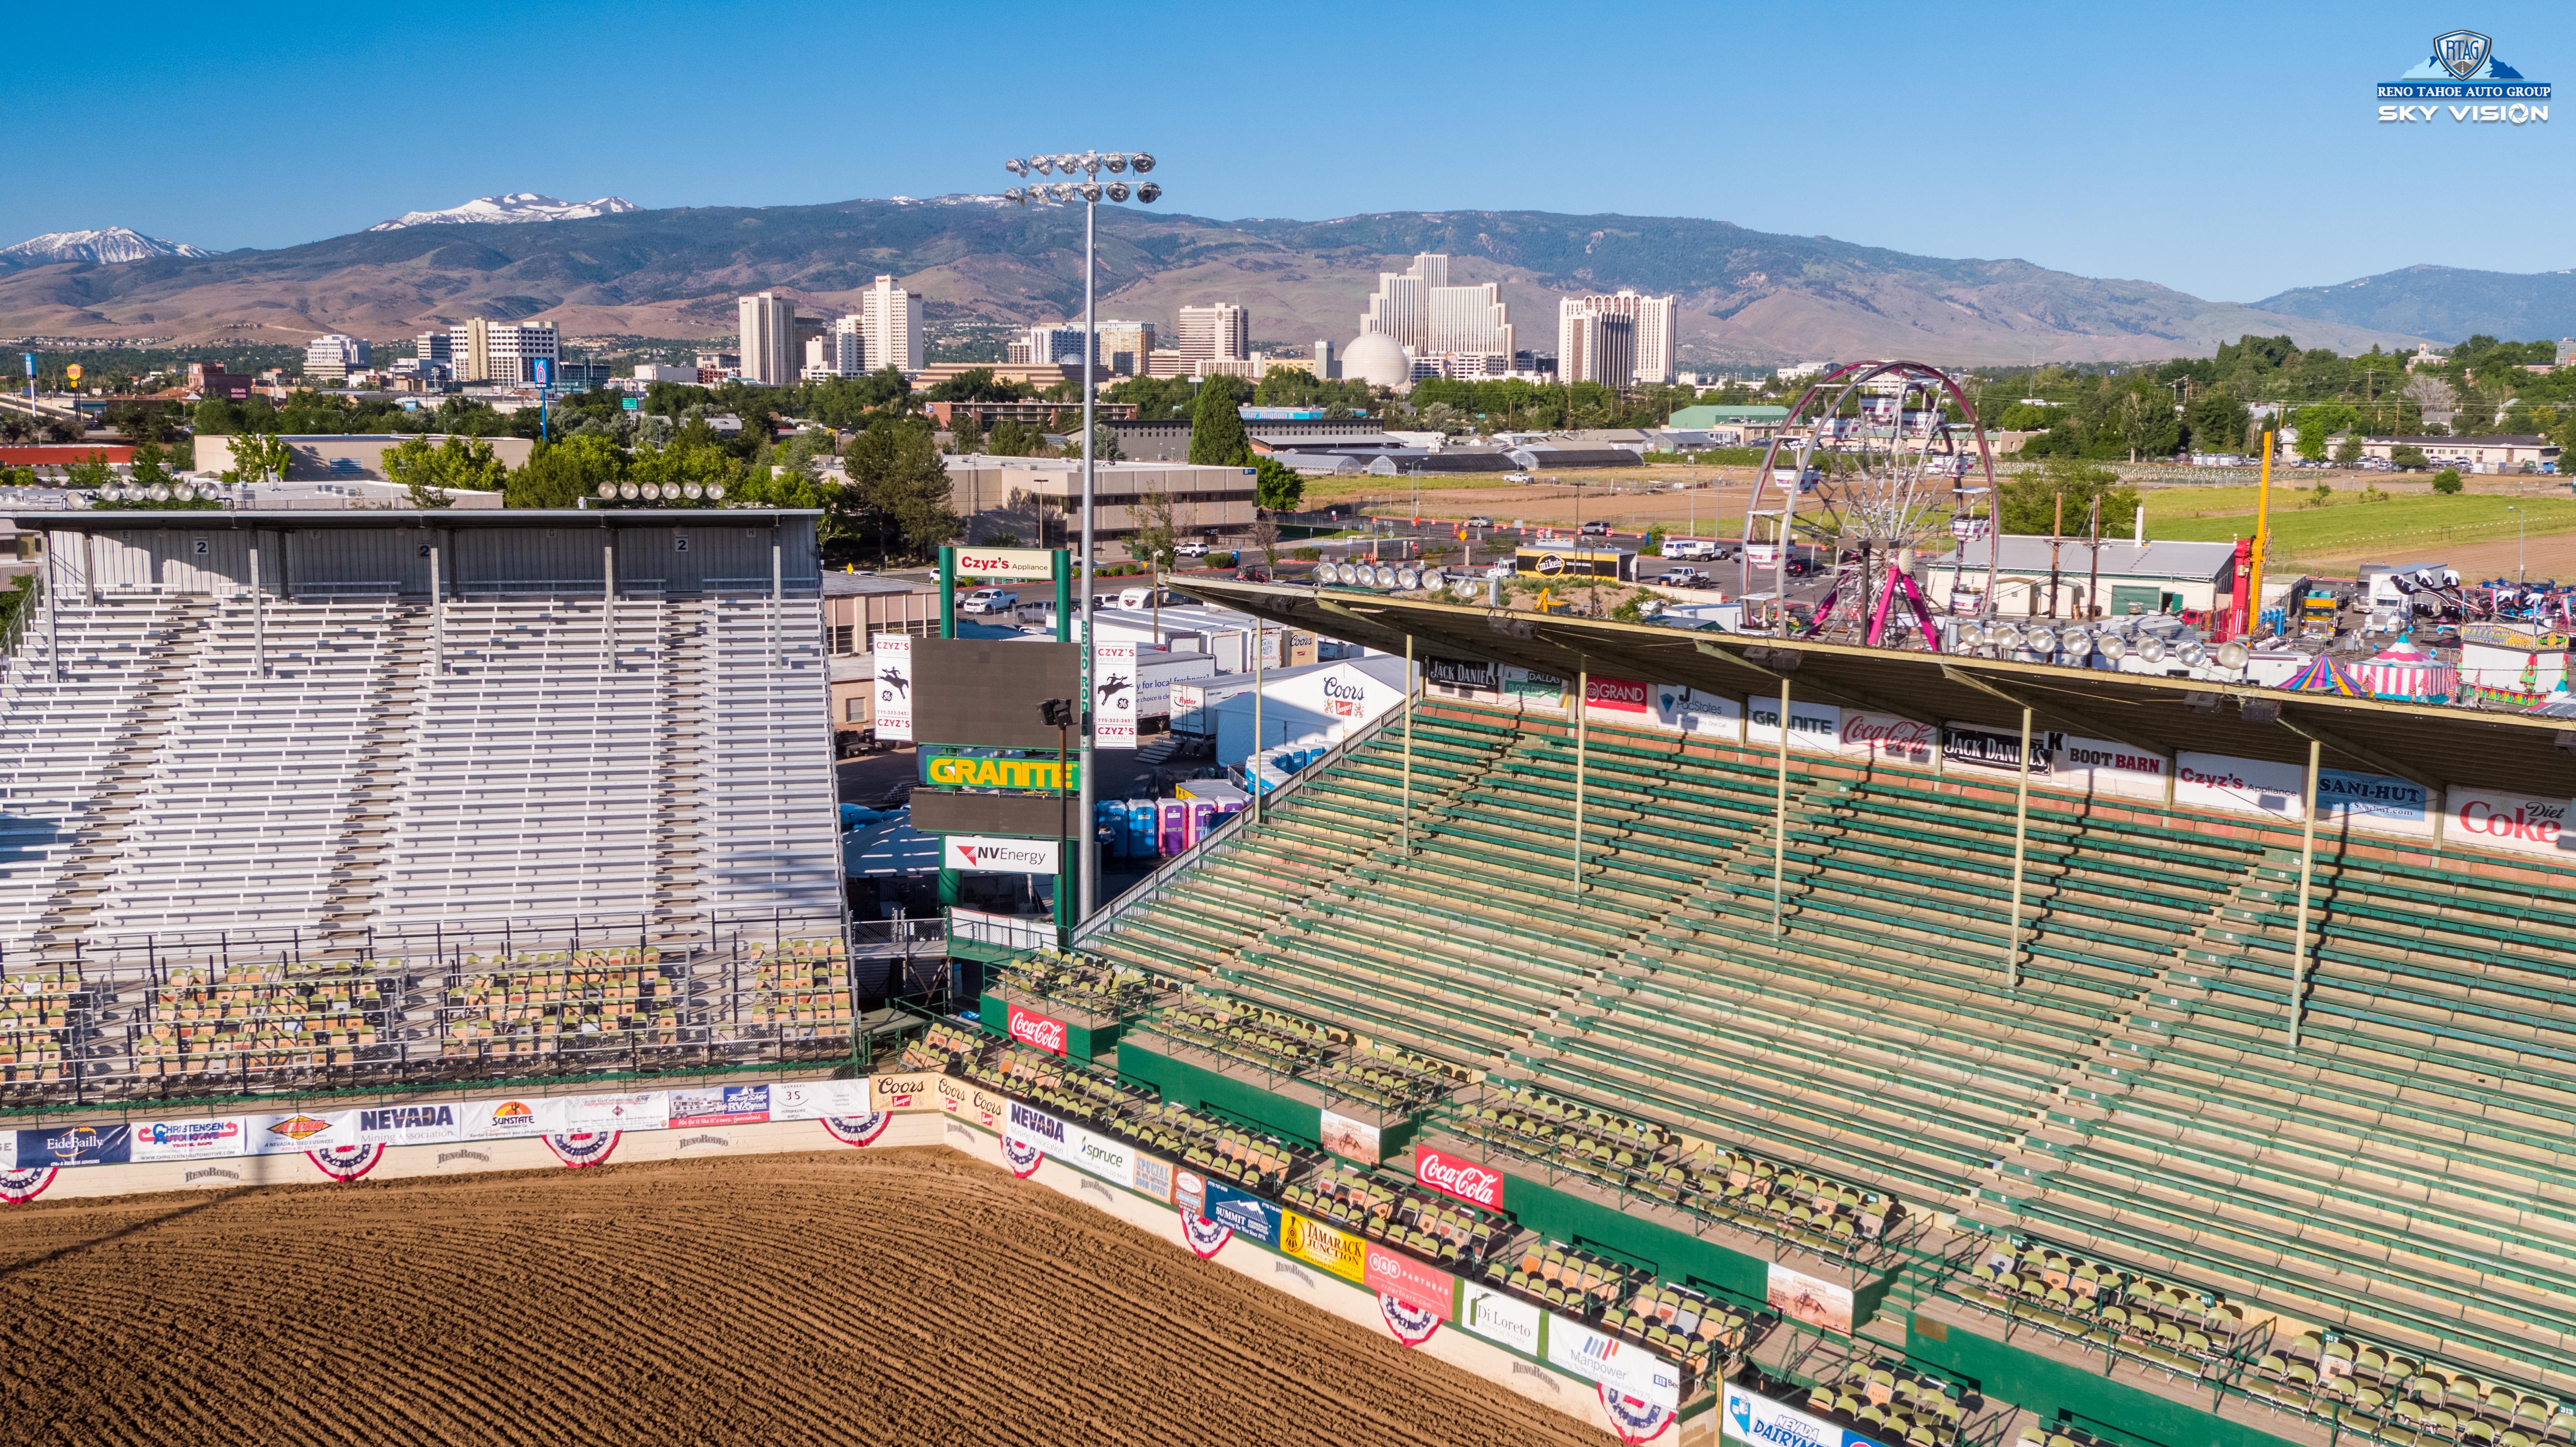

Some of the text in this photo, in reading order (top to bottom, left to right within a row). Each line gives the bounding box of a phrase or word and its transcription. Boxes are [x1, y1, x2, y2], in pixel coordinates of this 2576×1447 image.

[537, 361, 545, 383] 6
[197, 542, 207, 553] 2
[420, 545, 430, 557] 2
[678, 540, 687, 550] 2
[962, 556, 1009, 571] Czyz's
[1540, 559, 1563, 571] mike's
[877, 642, 909, 650] CZYZ'S
[1290, 635, 1312, 647] Coors
[1155, 678, 1172, 688] local
[1430, 661, 1455, 681] JACK
[1458, 664, 1496, 685] DANIELS
[1529, 673, 1560, 683] DALLAS
[1324, 677, 1364, 701] Coors
[1509, 684, 1529, 693] FLOOR
[1600, 684, 1644, 702] GRAND
[1179, 697, 1197, 705] Ryder
[877, 719, 910, 727] CZYZ'S
[1098, 727, 1134, 735] CZYZ'S
[1843, 716, 1932, 755] Coca-Cola
[2048, 732, 2064, 751] K
[1944, 733, 1982, 758] JACK
[1985, 738, 2047, 767] DANIL'S.
[2070, 747, 2160, 773] BOOT BARN
[930, 758, 1072, 788] GRANITE
[2180, 767, 2297, 796] Czyz's Appliance
[2318, 778, 2420, 803] SANI-HUT
[2459, 801, 2561, 844] Coke
[2525, 802, 2565, 819] Diet
[1010, 1012, 1063, 1049] Coca-Cola
[878, 1077, 925, 1094] Coors
[938, 1077, 966, 1101] Coors
[973, 1090, 1001, 1115] Coors
[361, 1106, 453, 1131] NEVADA
[492, 1115, 535, 1126] SUNSTATE
[1010, 1103, 1065, 1143] NEVADA
[361, 1129, 453, 1143] Mining ssociation
[1010, 1126, 1063, 1154] Mining Association
[1086, 1144, 1122, 1167] spruce
[1137, 1157, 1168, 1182] SPECIAL
[1420, 1154, 1498, 1205] Coca-Cola
[1216, 1207, 1246, 1225] SUMMIT
[1307, 1221, 1362, 1257] TAMARACK
[1307, 1242, 1359, 1266] JUNCTION
[1402, 1270, 1448, 1296] PARTNERS
[1478, 1305, 1530, 1337] Di Loreto
[1571, 1349, 1627, 1381] Manpower
[1776, 1415, 1820, 1441] NEVADA
